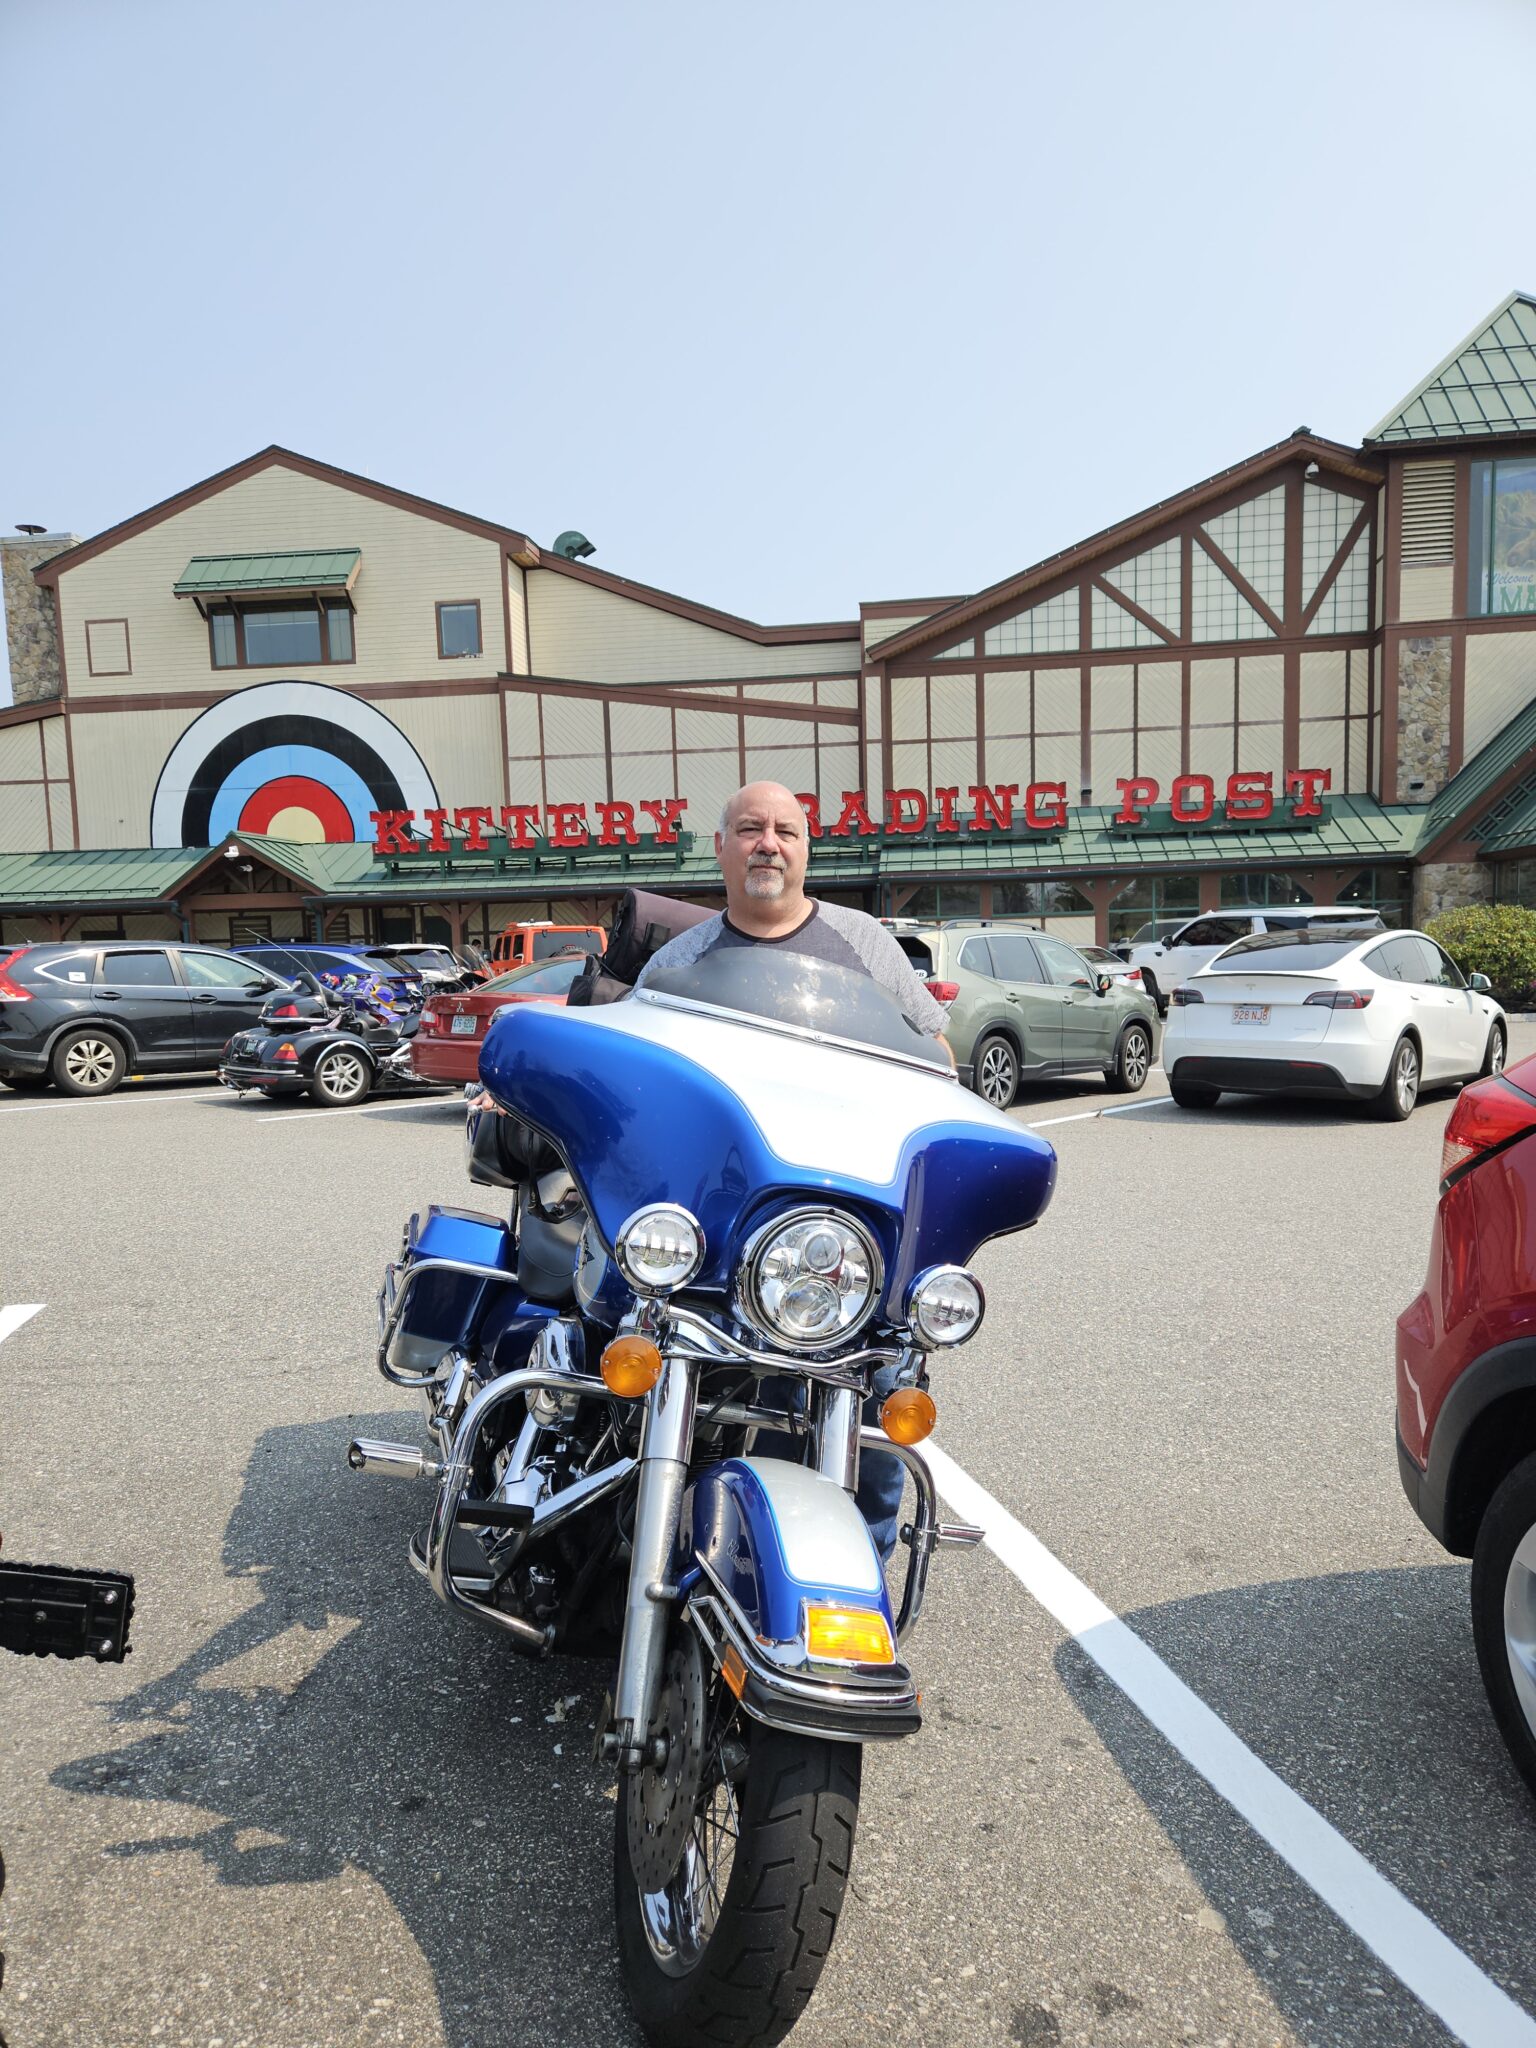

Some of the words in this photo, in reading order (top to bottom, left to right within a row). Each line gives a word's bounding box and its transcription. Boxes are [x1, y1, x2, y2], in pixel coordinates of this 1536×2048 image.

[370, 799, 688, 854] KITTERY
[794, 781, 1068, 838] RADING
[1115, 768, 1331, 824] POST
